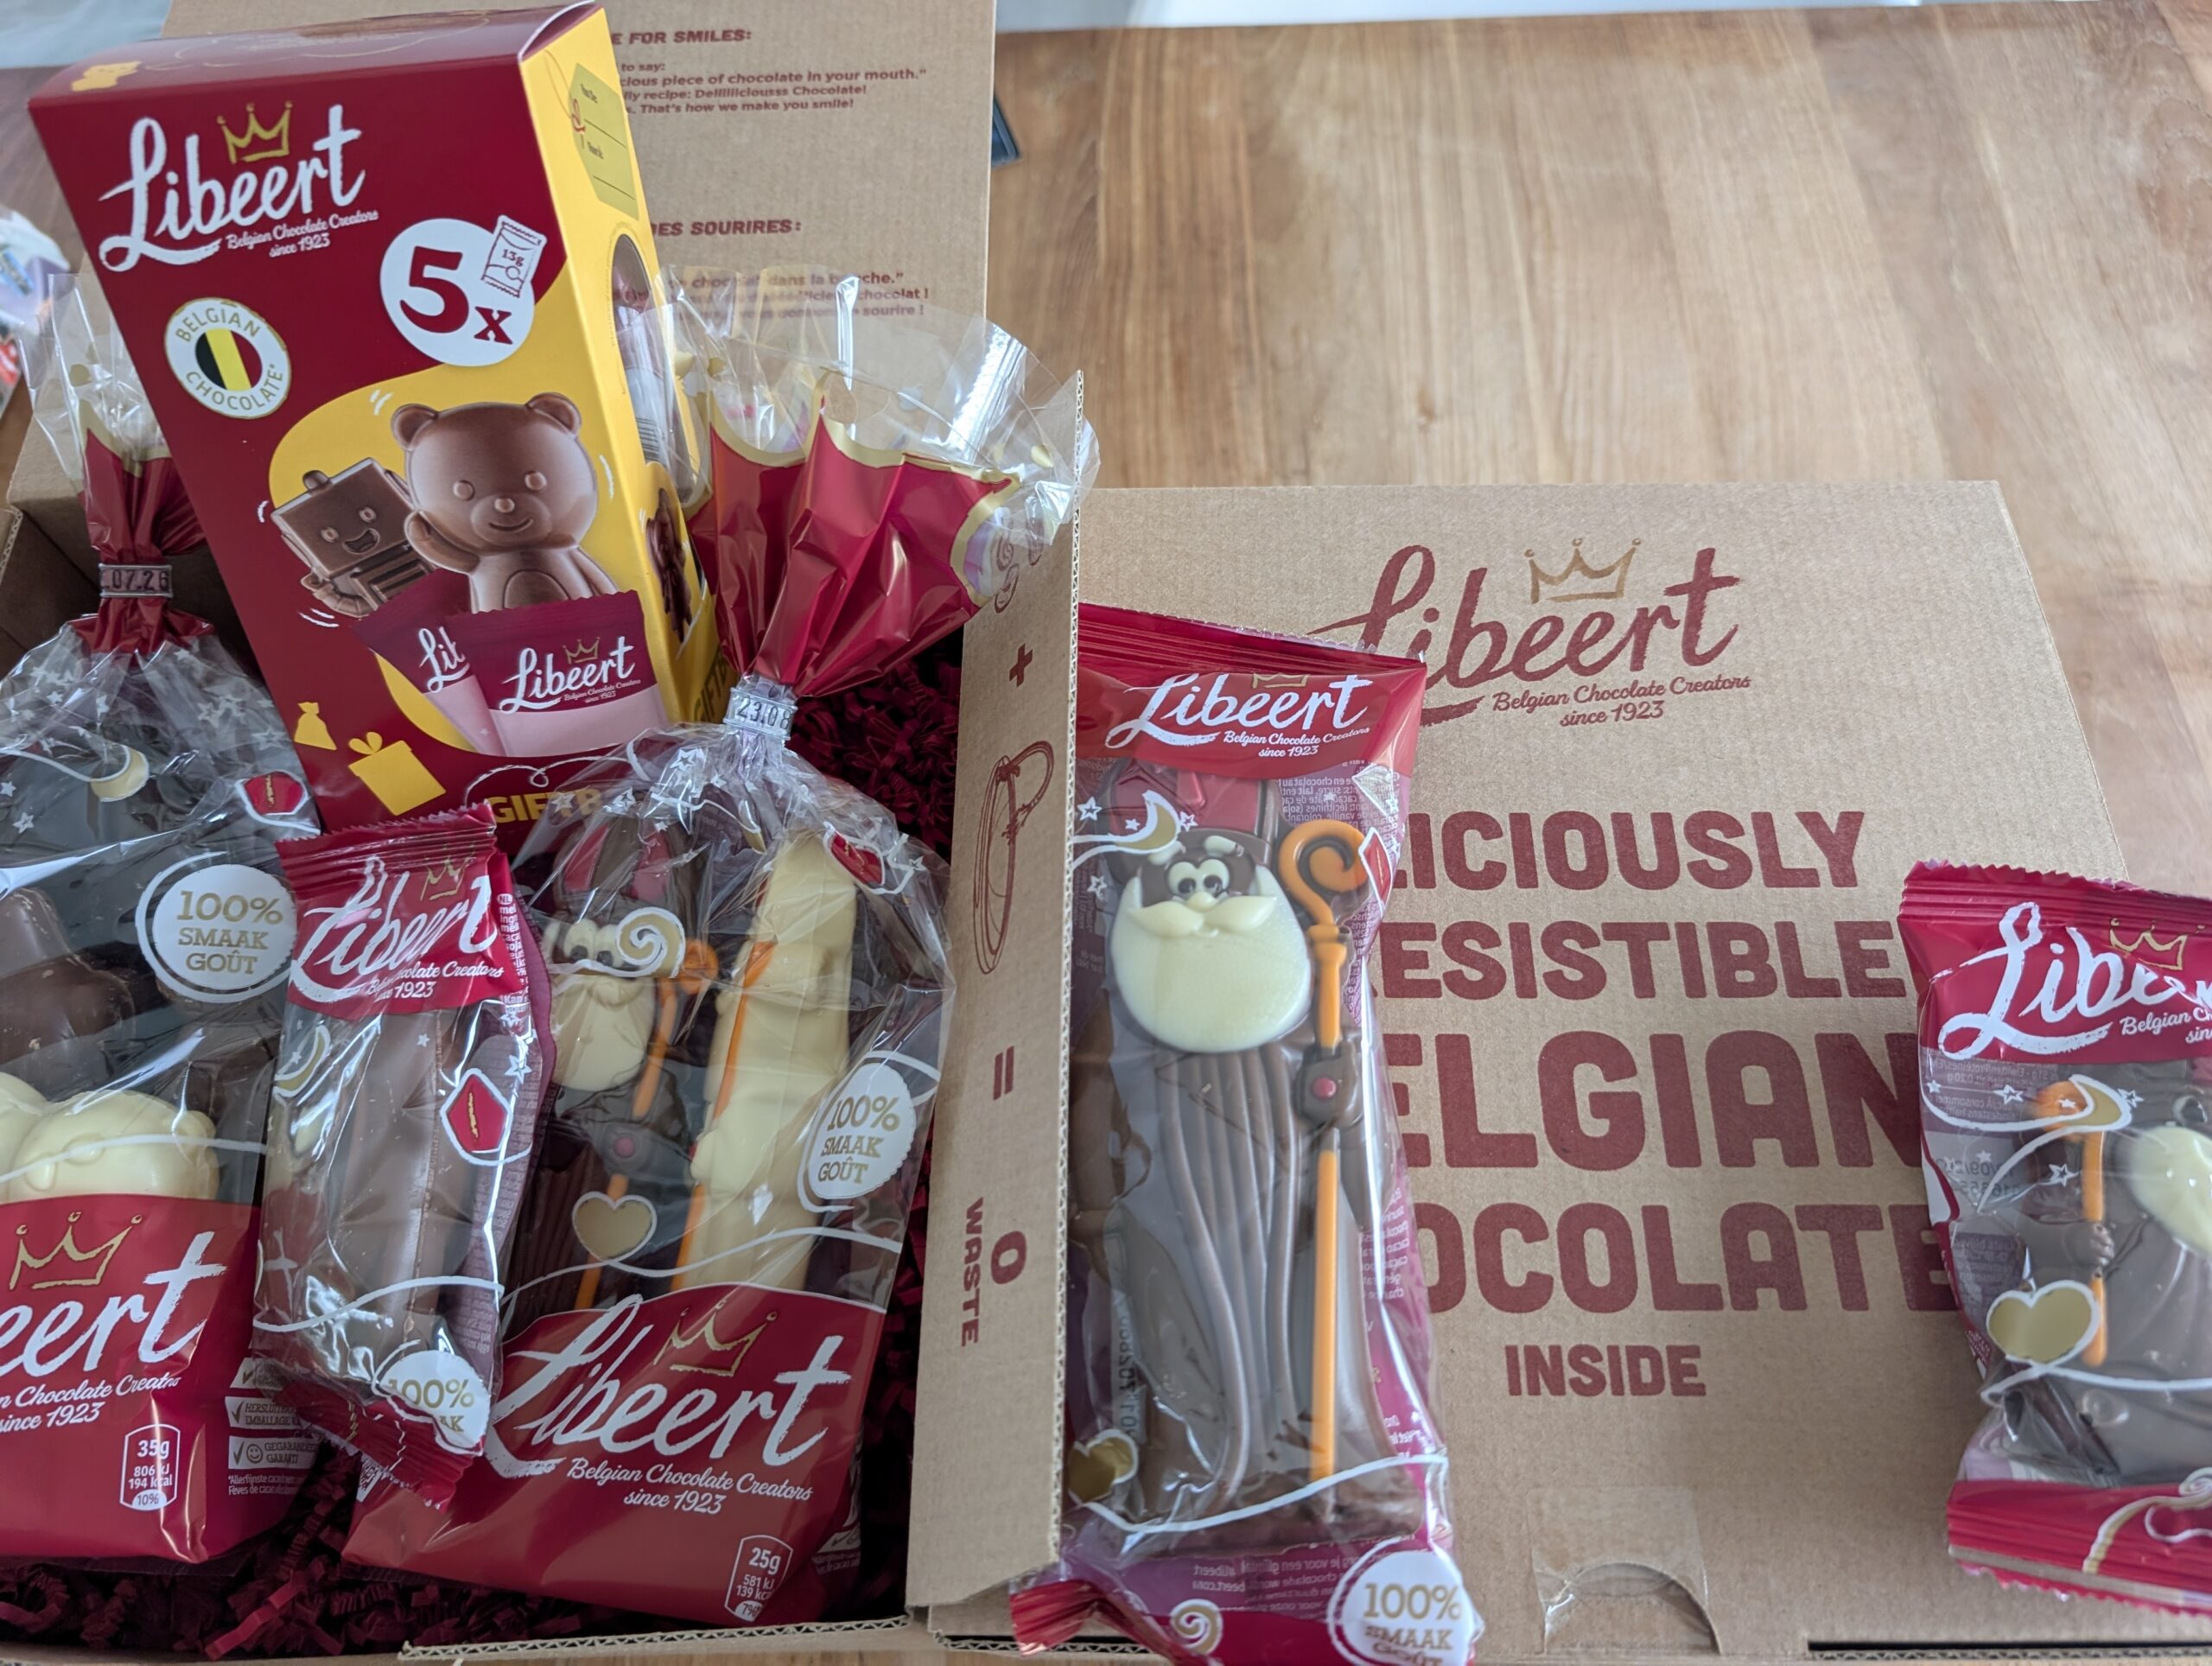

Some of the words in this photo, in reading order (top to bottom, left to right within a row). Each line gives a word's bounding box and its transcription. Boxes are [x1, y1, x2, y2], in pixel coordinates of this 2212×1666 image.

[629, 32, 666, 45] FOR
[674, 29, 752, 43] SMILES:
[621, 63, 635, 72] to
[639, 63, 665, 73] say:
[662, 74, 704, 87] piece
[708, 73, 724, 85] of
[728, 71, 803, 85] chocolate
[807, 70, 821, 81] in
[825, 71, 861, 83] your
[644, 90, 690, 100] recipe:
[793, 85, 867, 95] Chocolate!
[640, 103, 682, 114] That's
[686, 101, 715, 112] how
[719, 103, 738, 112] we
[741, 100, 779, 111] make
[783, 99, 809, 111] you
[812, 99, 854, 109] smile!
[98, 104, 365, 272] Libeert
[226, 231, 272, 250] Belgian
[273, 219, 327, 240] Chocolate
[329, 209, 378, 230] Creators
[270, 244, 297, 258] since
[299, 232, 330, 252] 1923
[501, 249, 525, 268] 13g
[811, 274, 824, 285] la
[830, 271, 904, 286] bche.”
[861, 305, 915, 316] sourire
[175, 307, 260, 342] BELGIAN
[1309, 544, 1742, 727] Libeert
[499, 636, 635, 715] Libeert
[563, 690, 587, 702] Belgian
[588, 684, 615, 696] Chocolate
[1492, 690, 1569, 715] Belgian
[1573, 678, 1665, 705] Chocolate
[1669, 673, 1751, 696] Creators
[1105, 672, 1374, 749] Libeert
[1559, 707, 1607, 727] since
[1611, 699, 1664, 722] 1923
[1224, 729, 1267, 746] Belgian
[1268, 732, 1322, 746] Chocolate
[1322, 726, 1370, 744] Creators
[1258, 747, 1287, 758] since
[1287, 745, 1319, 756] 1923
[1392, 810, 1865, 890] ICIOUSLY
[176, 890, 283, 925] 100%
[178, 927, 269, 950] SMAAK
[186, 950, 257, 975] GOÛT
[442, 961, 505, 979] Creators
[1372, 920, 1906, 1001] ESISTIBLE
[394, 981, 436, 998] 1923
[2120, 1011, 2191, 1035] Belgian
[826, 1094, 900, 1131] 100%
[821, 1134, 885, 1158] SMAAK
[817, 1156, 868, 1185] GOÛT
[961, 1197, 984, 1347] WASTE
[1504, 1345, 1707, 1397] INSIDE
[15, 1380, 113, 1408] Chocolate
[116, 1371, 181, 1396] Creats
[484, 1294, 852, 1478] Libeert
[46, 1401, 105, 1428] 1923
[137, 1439, 170, 1460] 35g
[128, 1477, 149, 1490] 194
[150, 1473, 173, 1488] kcal
[133, 1465, 156, 1478] 806
[567, 1457, 643, 1487] Belgian
[645, 1459, 734, 1491] Chocolate
[736, 1472, 814, 1502] Creators
[137, 1492, 160, 1506] 10%
[624, 1489, 670, 1508] since
[674, 1491, 727, 1516] 1923
[748, 1547, 782, 1576] 25g
[736, 1584, 753, 1599] 139
[742, 1574, 761, 1587] 581
[1364, 1582, 1462, 1620] 100%
[1364, 1625, 1453, 1650] SMAAK
